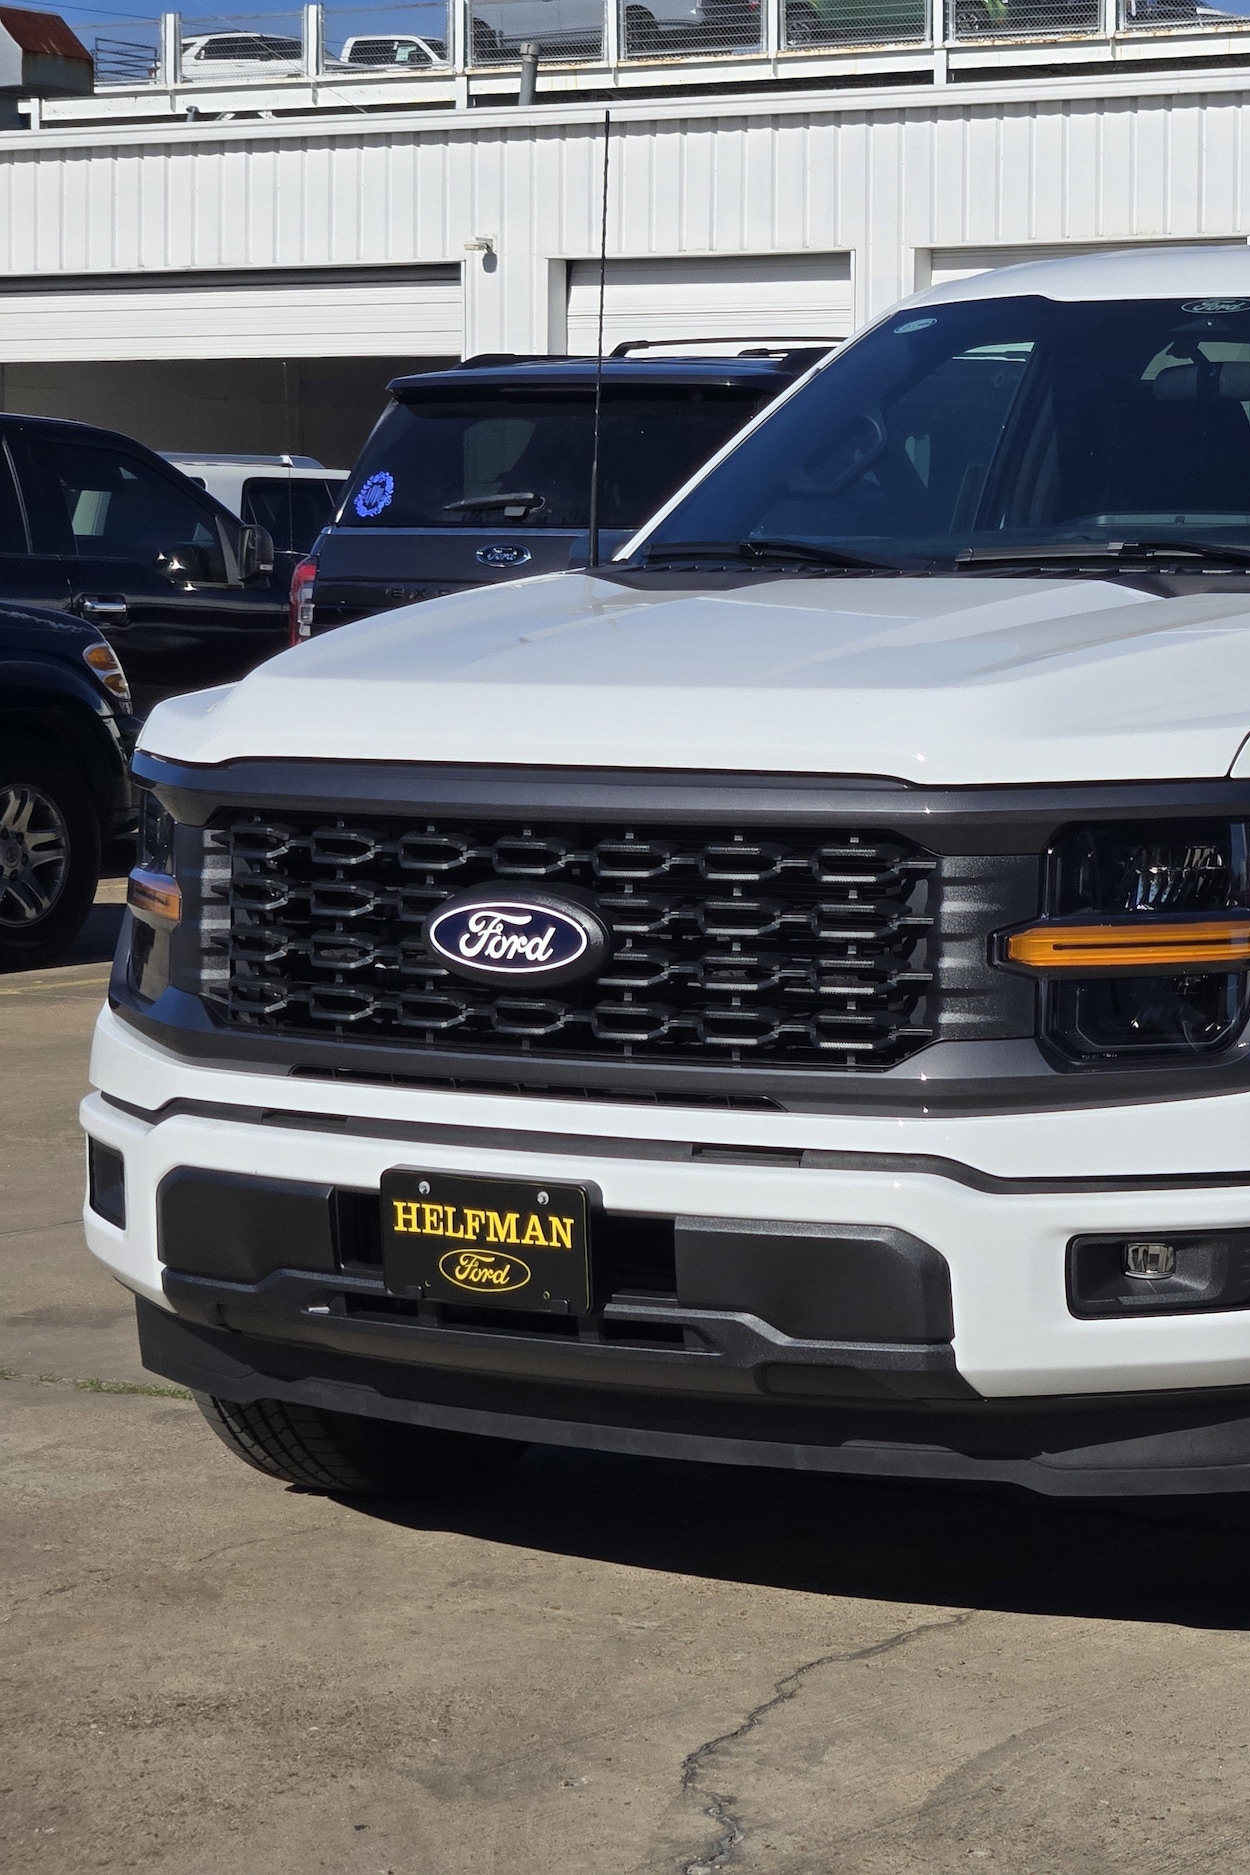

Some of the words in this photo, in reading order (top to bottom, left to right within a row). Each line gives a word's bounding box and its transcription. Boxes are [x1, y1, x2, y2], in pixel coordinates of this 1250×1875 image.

[1193, 299, 1246, 311] Ford
[459, 911, 556, 962] Ford
[392, 1201, 575, 1248] HELFMAN
[455, 1253, 511, 1285] Ford
